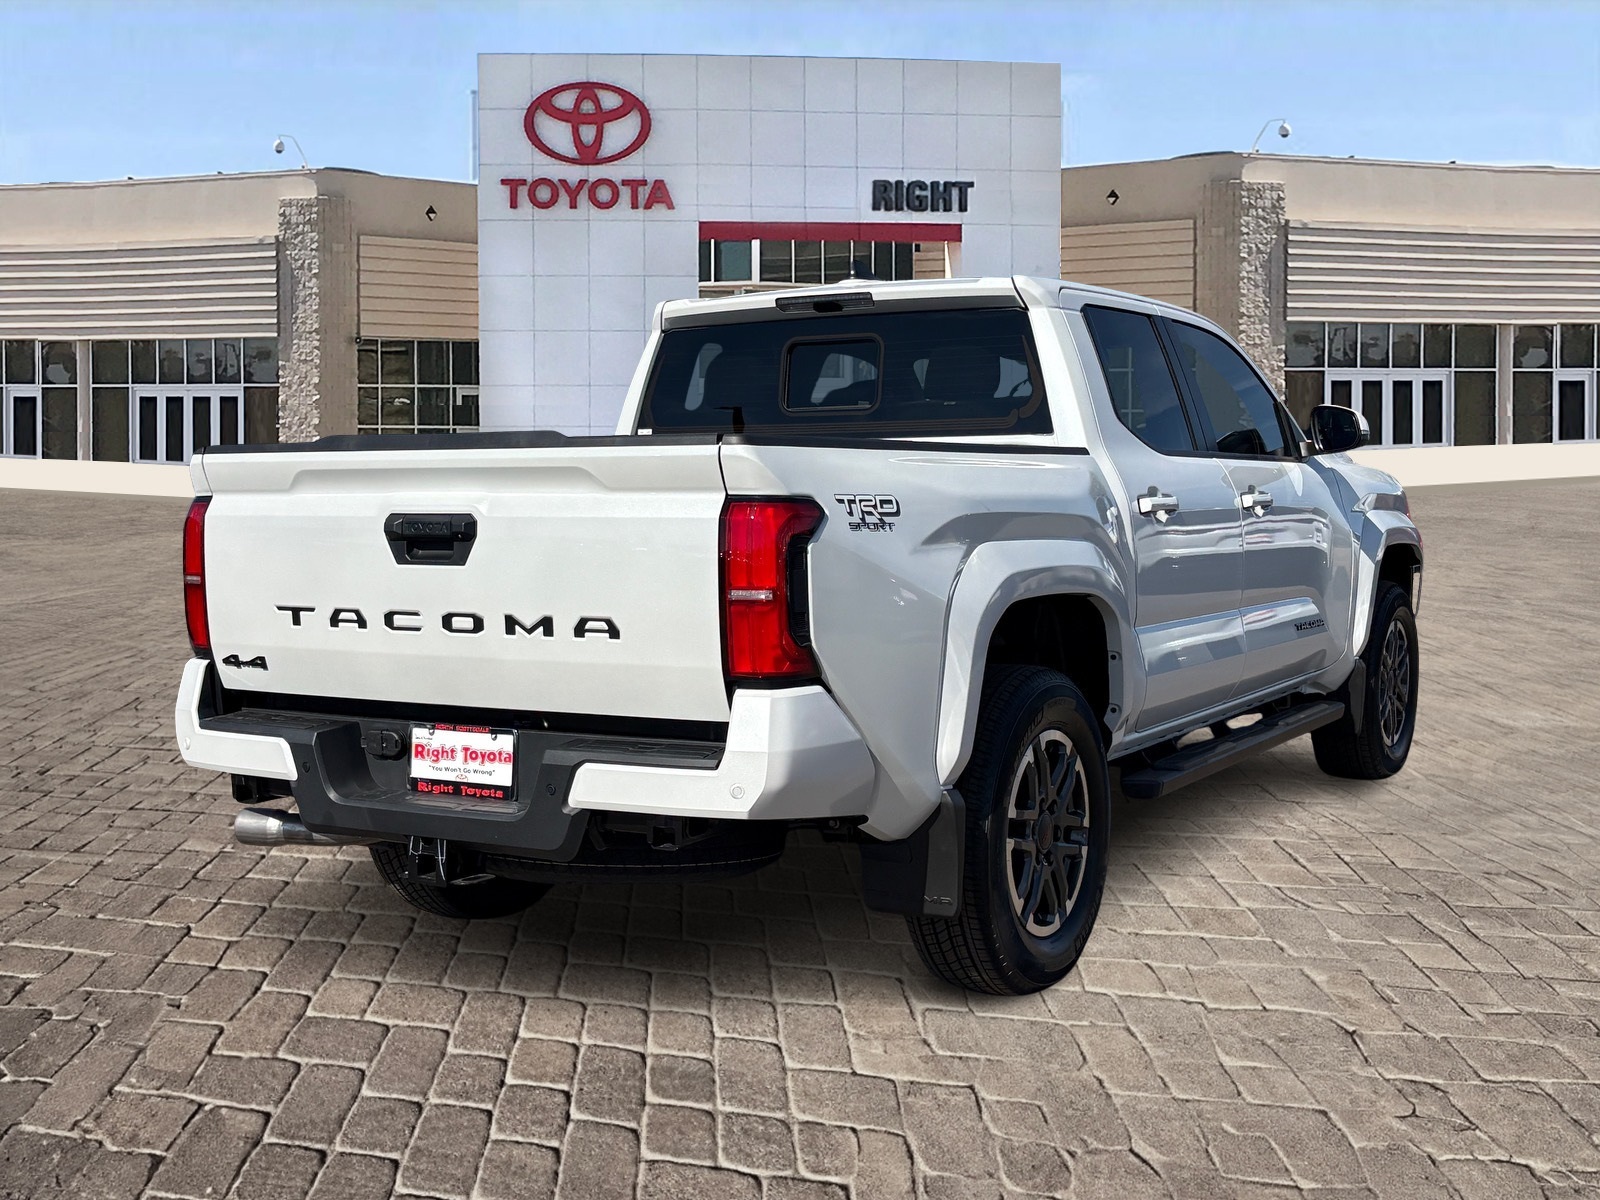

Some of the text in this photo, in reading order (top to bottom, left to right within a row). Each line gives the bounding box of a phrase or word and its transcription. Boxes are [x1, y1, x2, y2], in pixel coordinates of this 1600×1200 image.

[501, 178, 675, 210] TOYOTA
[872, 180, 975, 213] RIGHT
[834, 494, 901, 523] TRD
[404, 521, 448, 534] TOYOTA
[848, 522, 895, 532] SPORT
[274, 604, 621, 641] TACOMA
[414, 743, 512, 765] Right Toyota
[417, 781, 503, 798] Right Toyota
